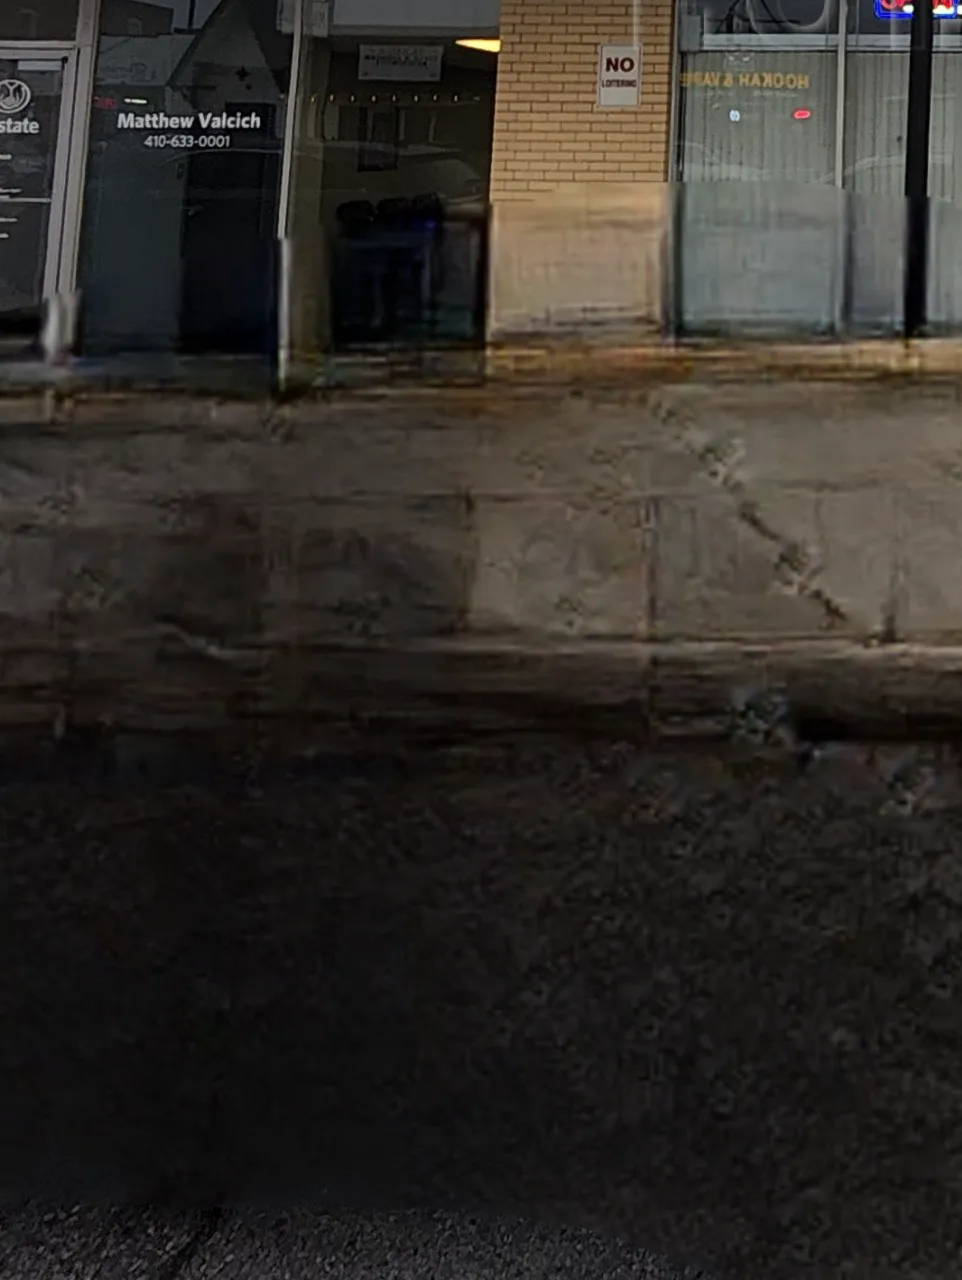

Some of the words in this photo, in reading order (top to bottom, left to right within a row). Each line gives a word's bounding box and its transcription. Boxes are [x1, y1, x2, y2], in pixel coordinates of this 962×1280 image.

[605, 57, 635, 73] NO
[601, 79, 637, 88] LOITERING
[117, 113, 194, 129] Matthew
[198, 112, 261, 128] Valcich
[144, 135, 231, 148] 410-633-0001
